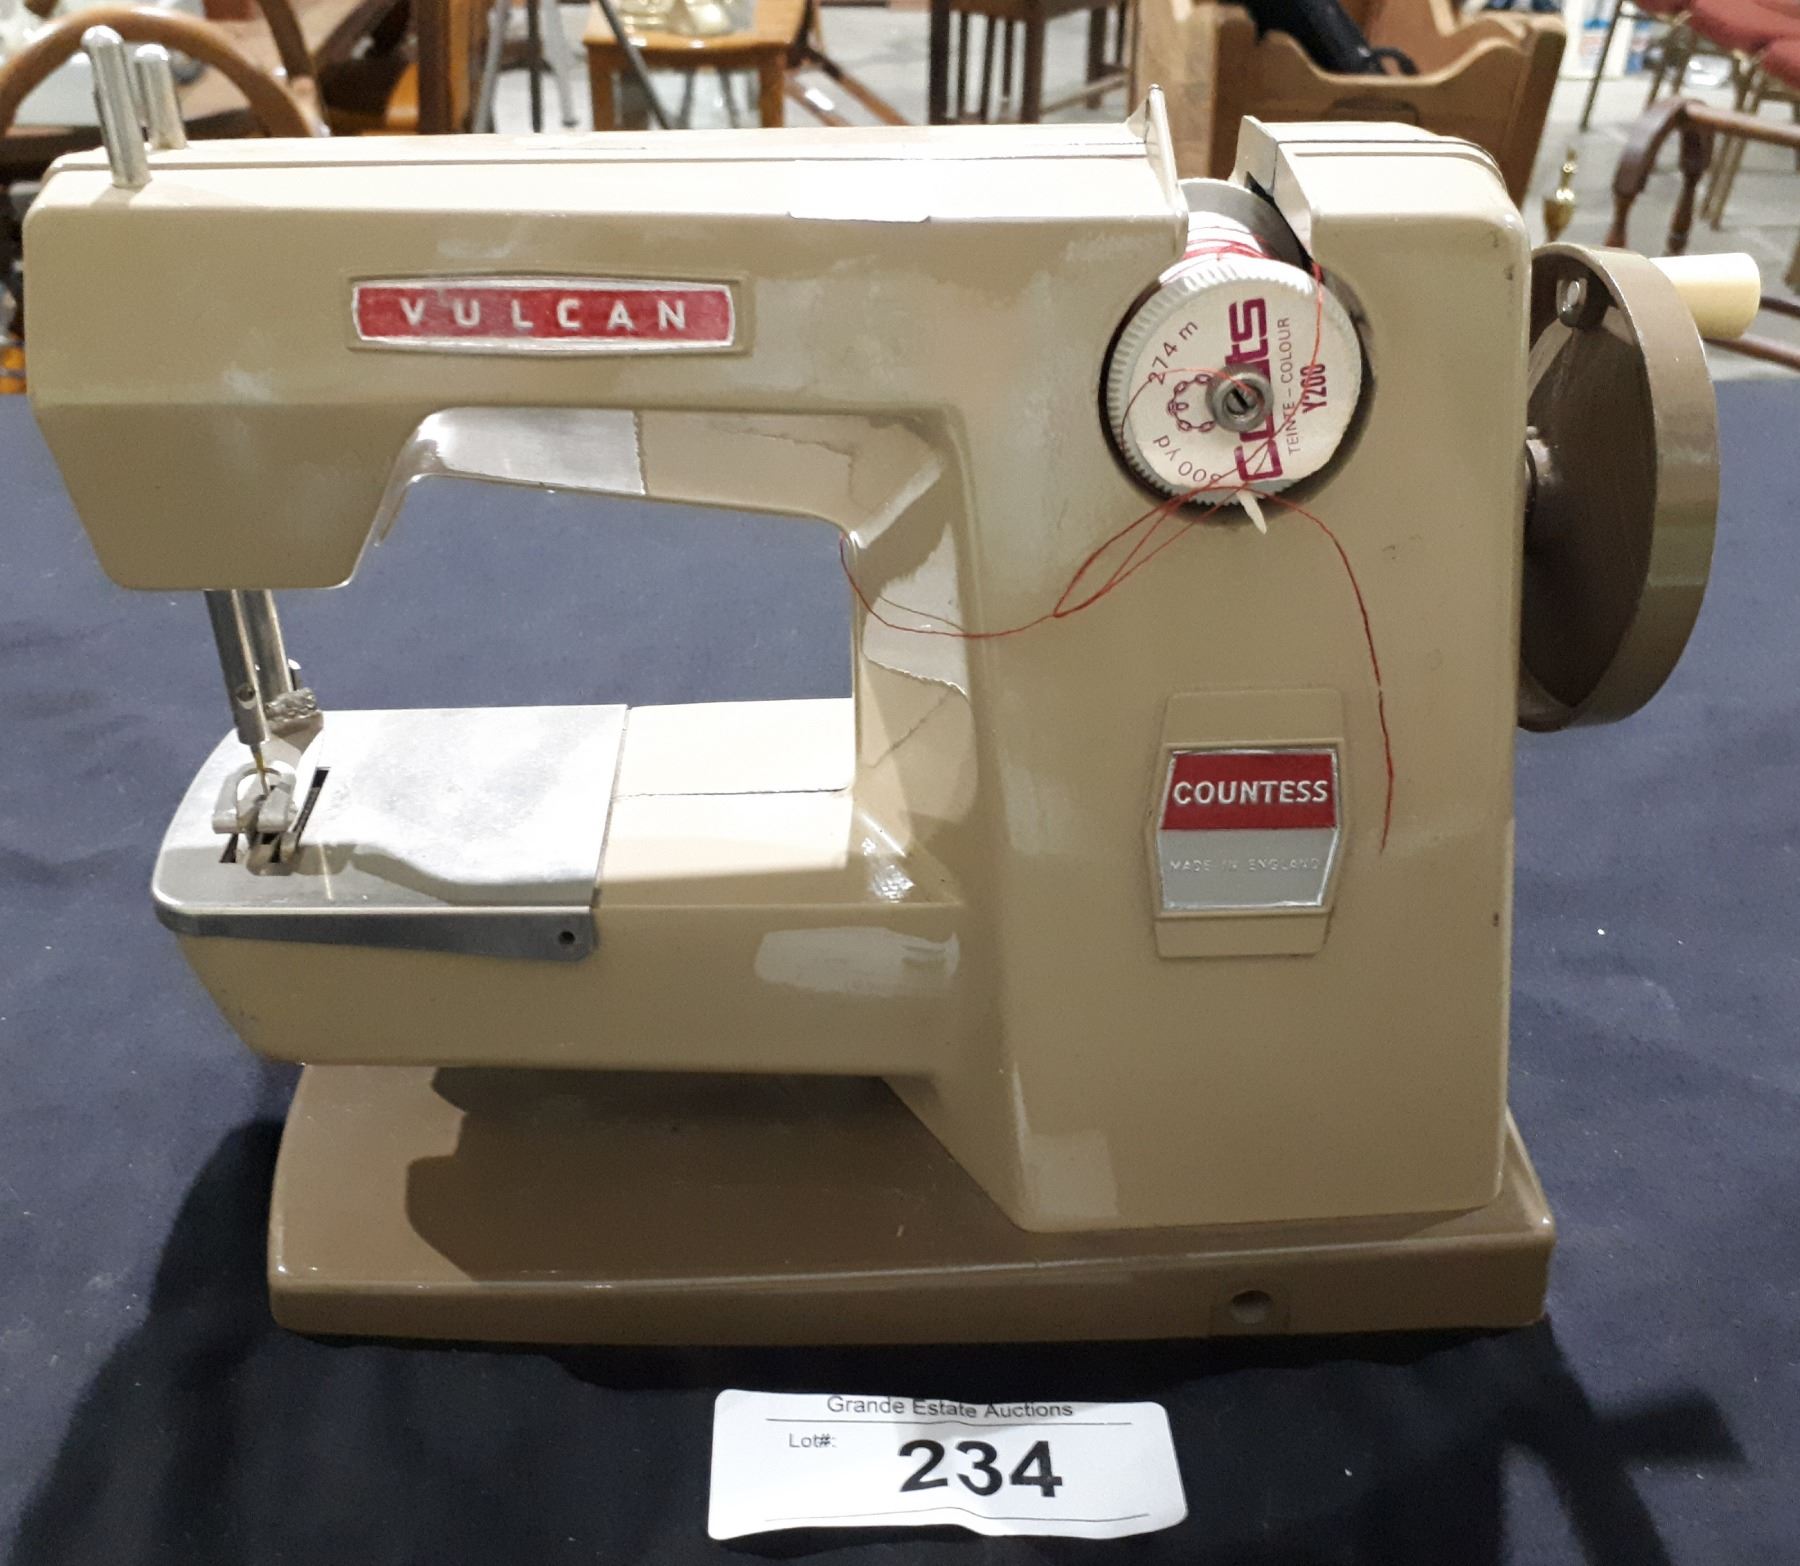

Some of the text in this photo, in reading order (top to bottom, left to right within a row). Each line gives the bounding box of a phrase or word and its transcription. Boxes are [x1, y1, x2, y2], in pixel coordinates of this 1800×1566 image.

[400, 298, 687, 331] VULCAN
[1148, 321, 1198, 385] 274 m
[1277, 317, 1293, 384] COLOUR
[1173, 780, 1329, 805] COUNTESS
[1170, 859, 1212, 872] MADE
[1248, 858, 1320, 871] ENGLAND
[827, 1395, 1074, 1419] Grande Estate Auctions
[789, 1434, 836, 1449] Lot#:
[898, 1438, 1064, 1498] 234
